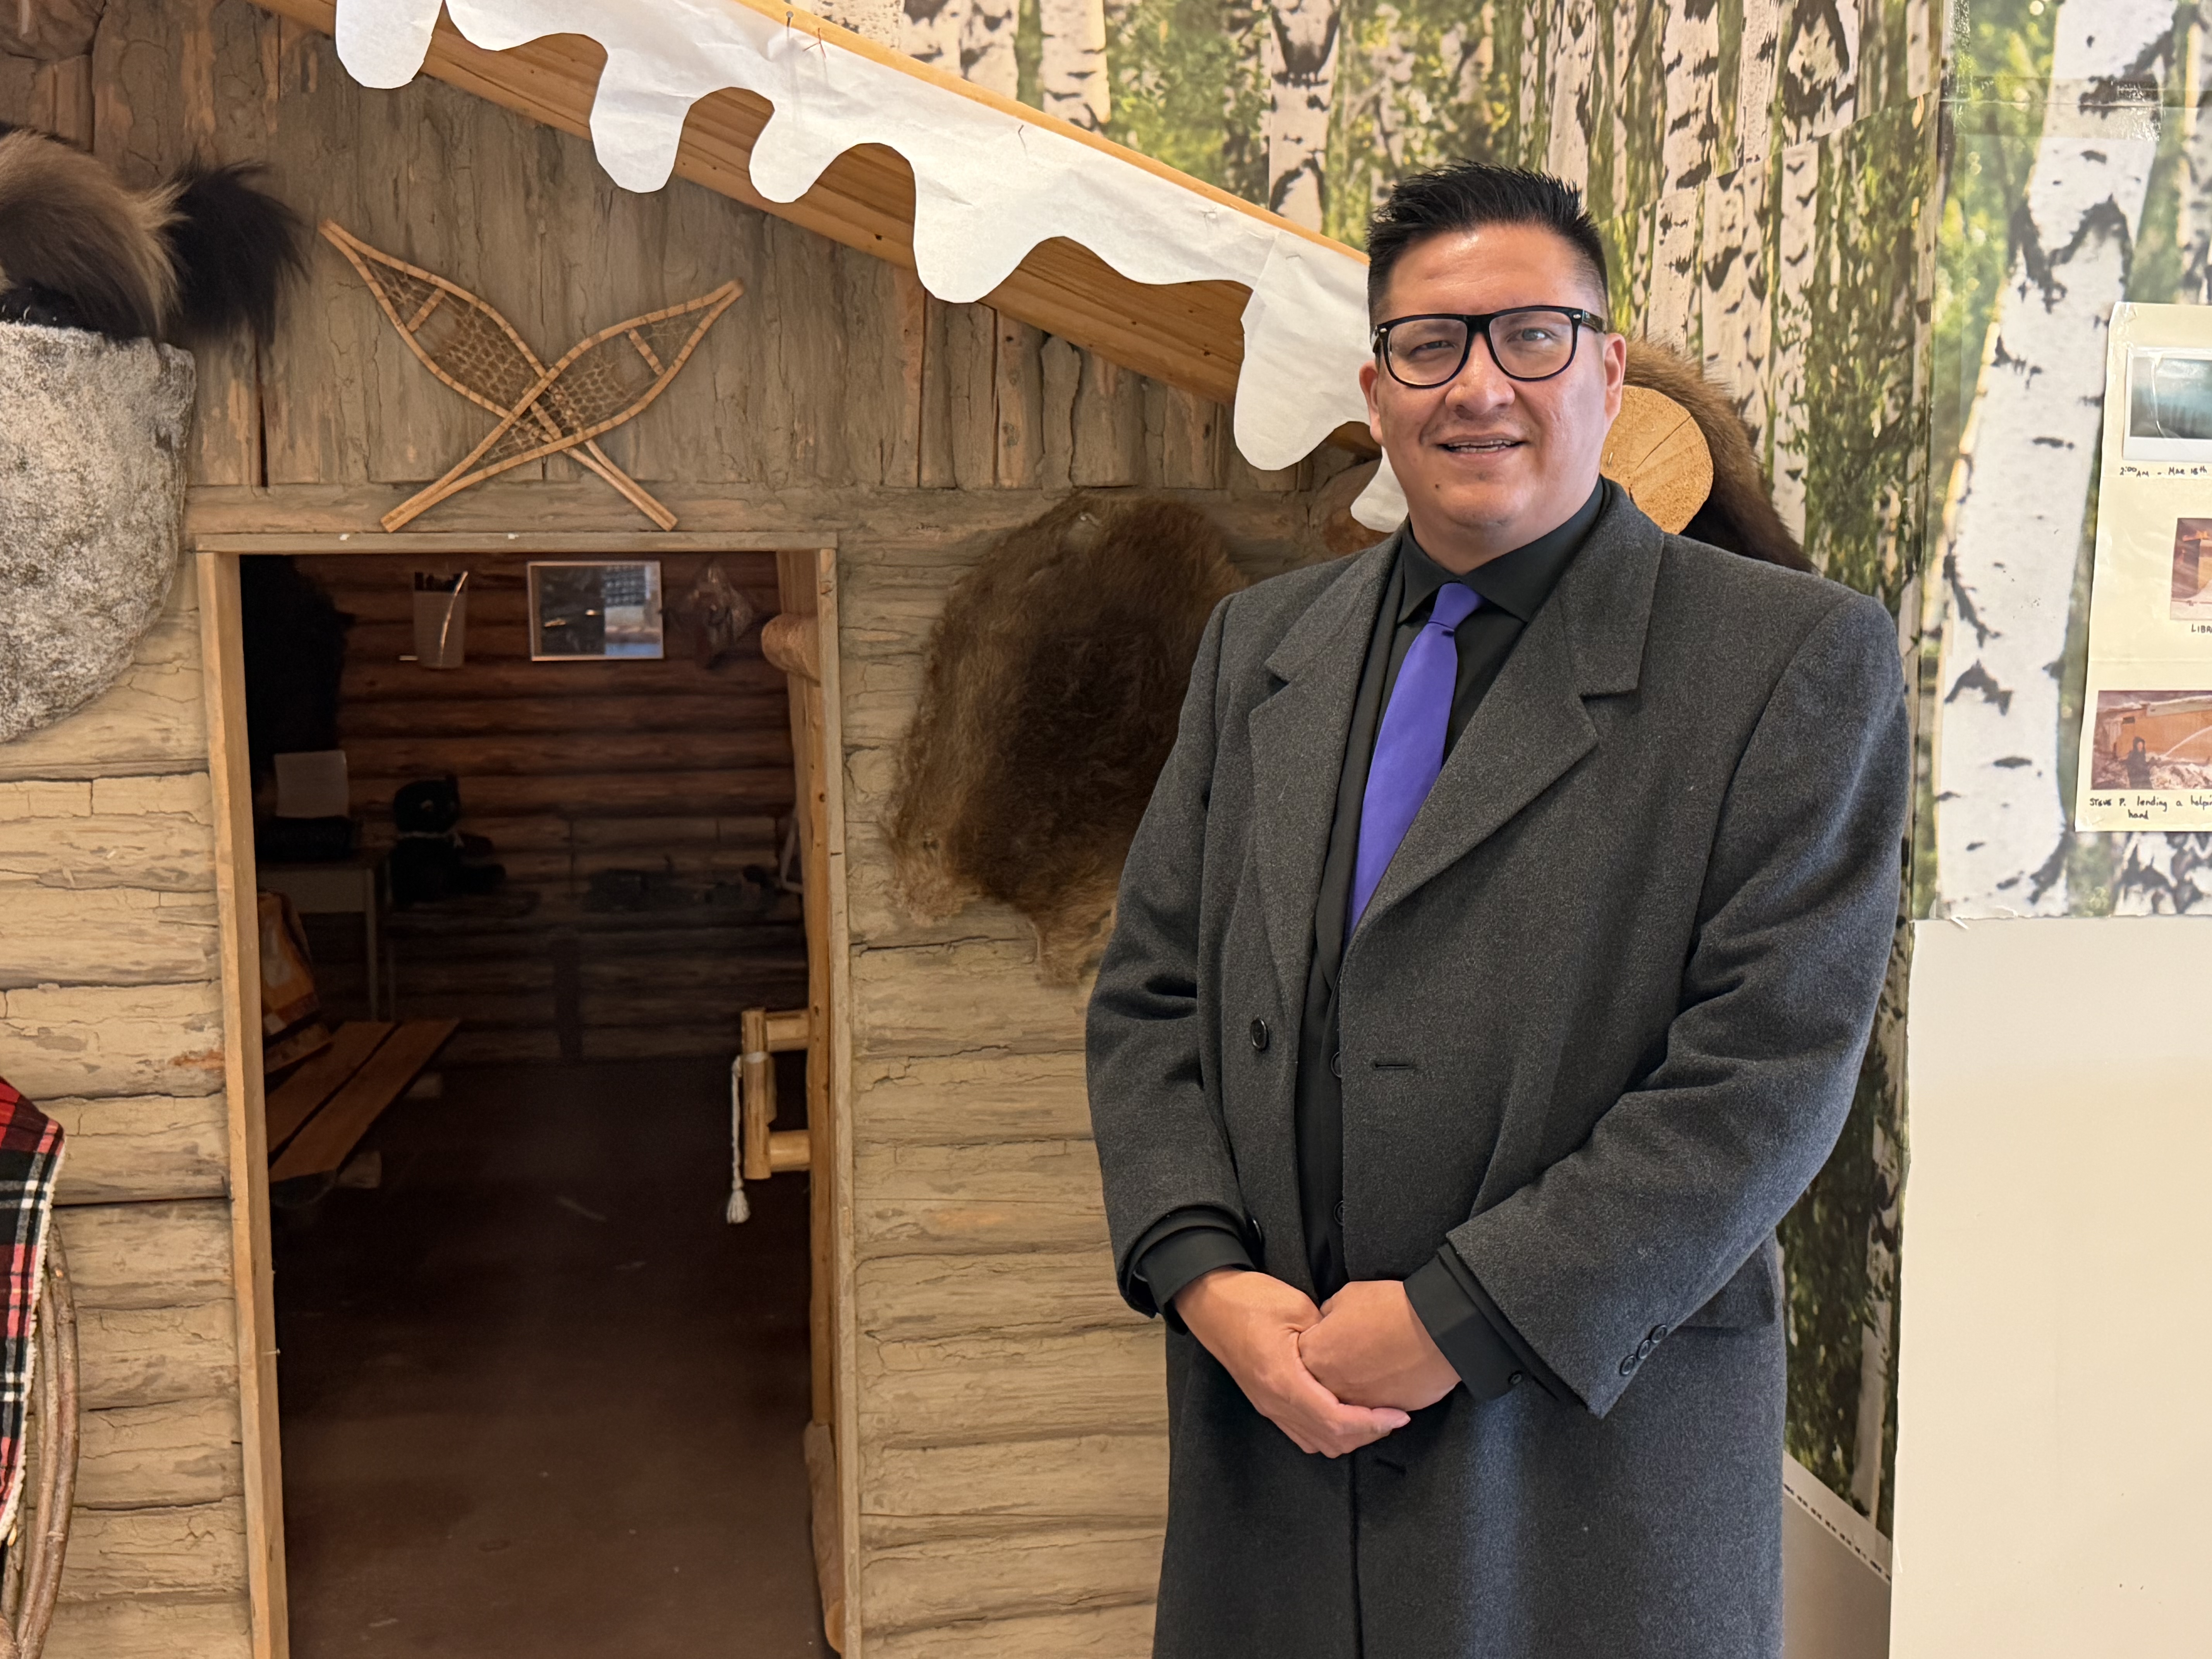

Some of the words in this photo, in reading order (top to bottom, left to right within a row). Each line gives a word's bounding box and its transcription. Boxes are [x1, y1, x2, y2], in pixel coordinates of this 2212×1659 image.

[2191, 623, 2212, 634] LIBR
[2137, 795, 2167, 812] lending
[2128, 809, 2149, 820] hand
